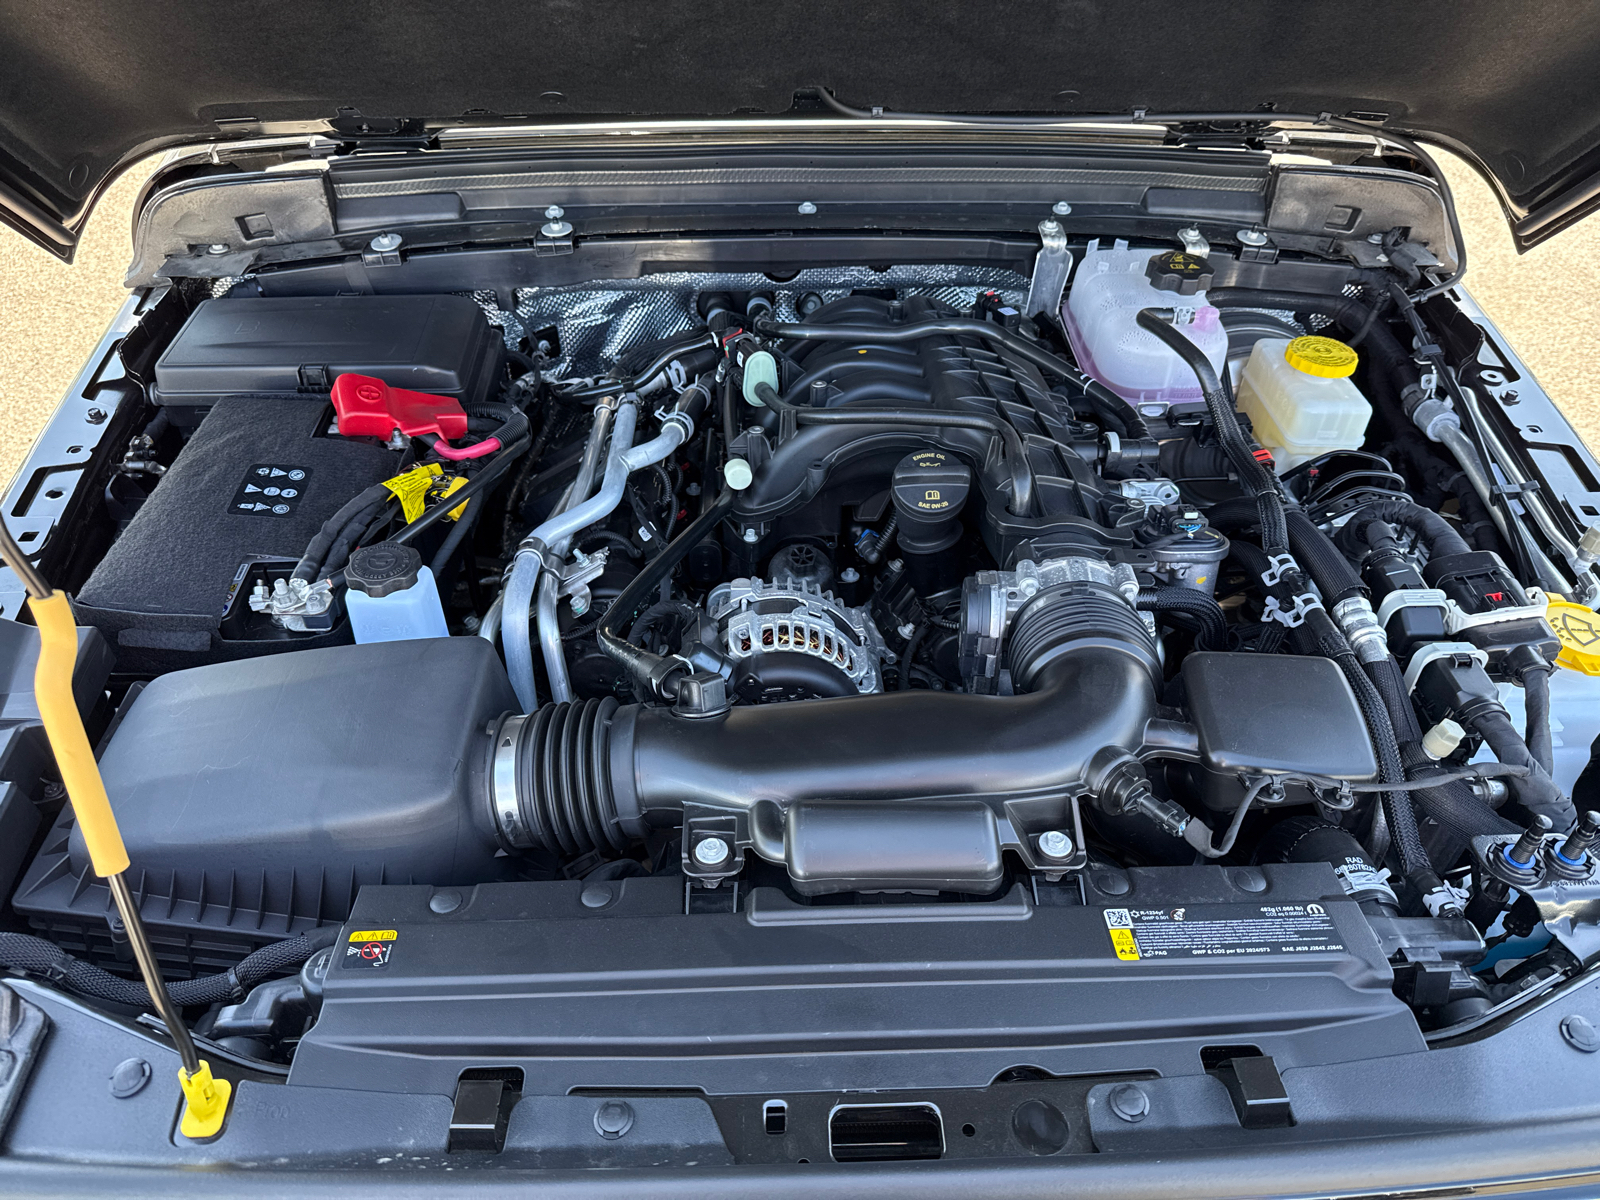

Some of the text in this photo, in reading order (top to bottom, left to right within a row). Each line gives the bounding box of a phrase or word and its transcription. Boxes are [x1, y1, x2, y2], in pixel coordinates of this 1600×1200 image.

[912, 452, 935, 461] ENGINE
[918, 501, 949, 509] SAE 0W-20
[1345, 856, 1363, 864] RAD
